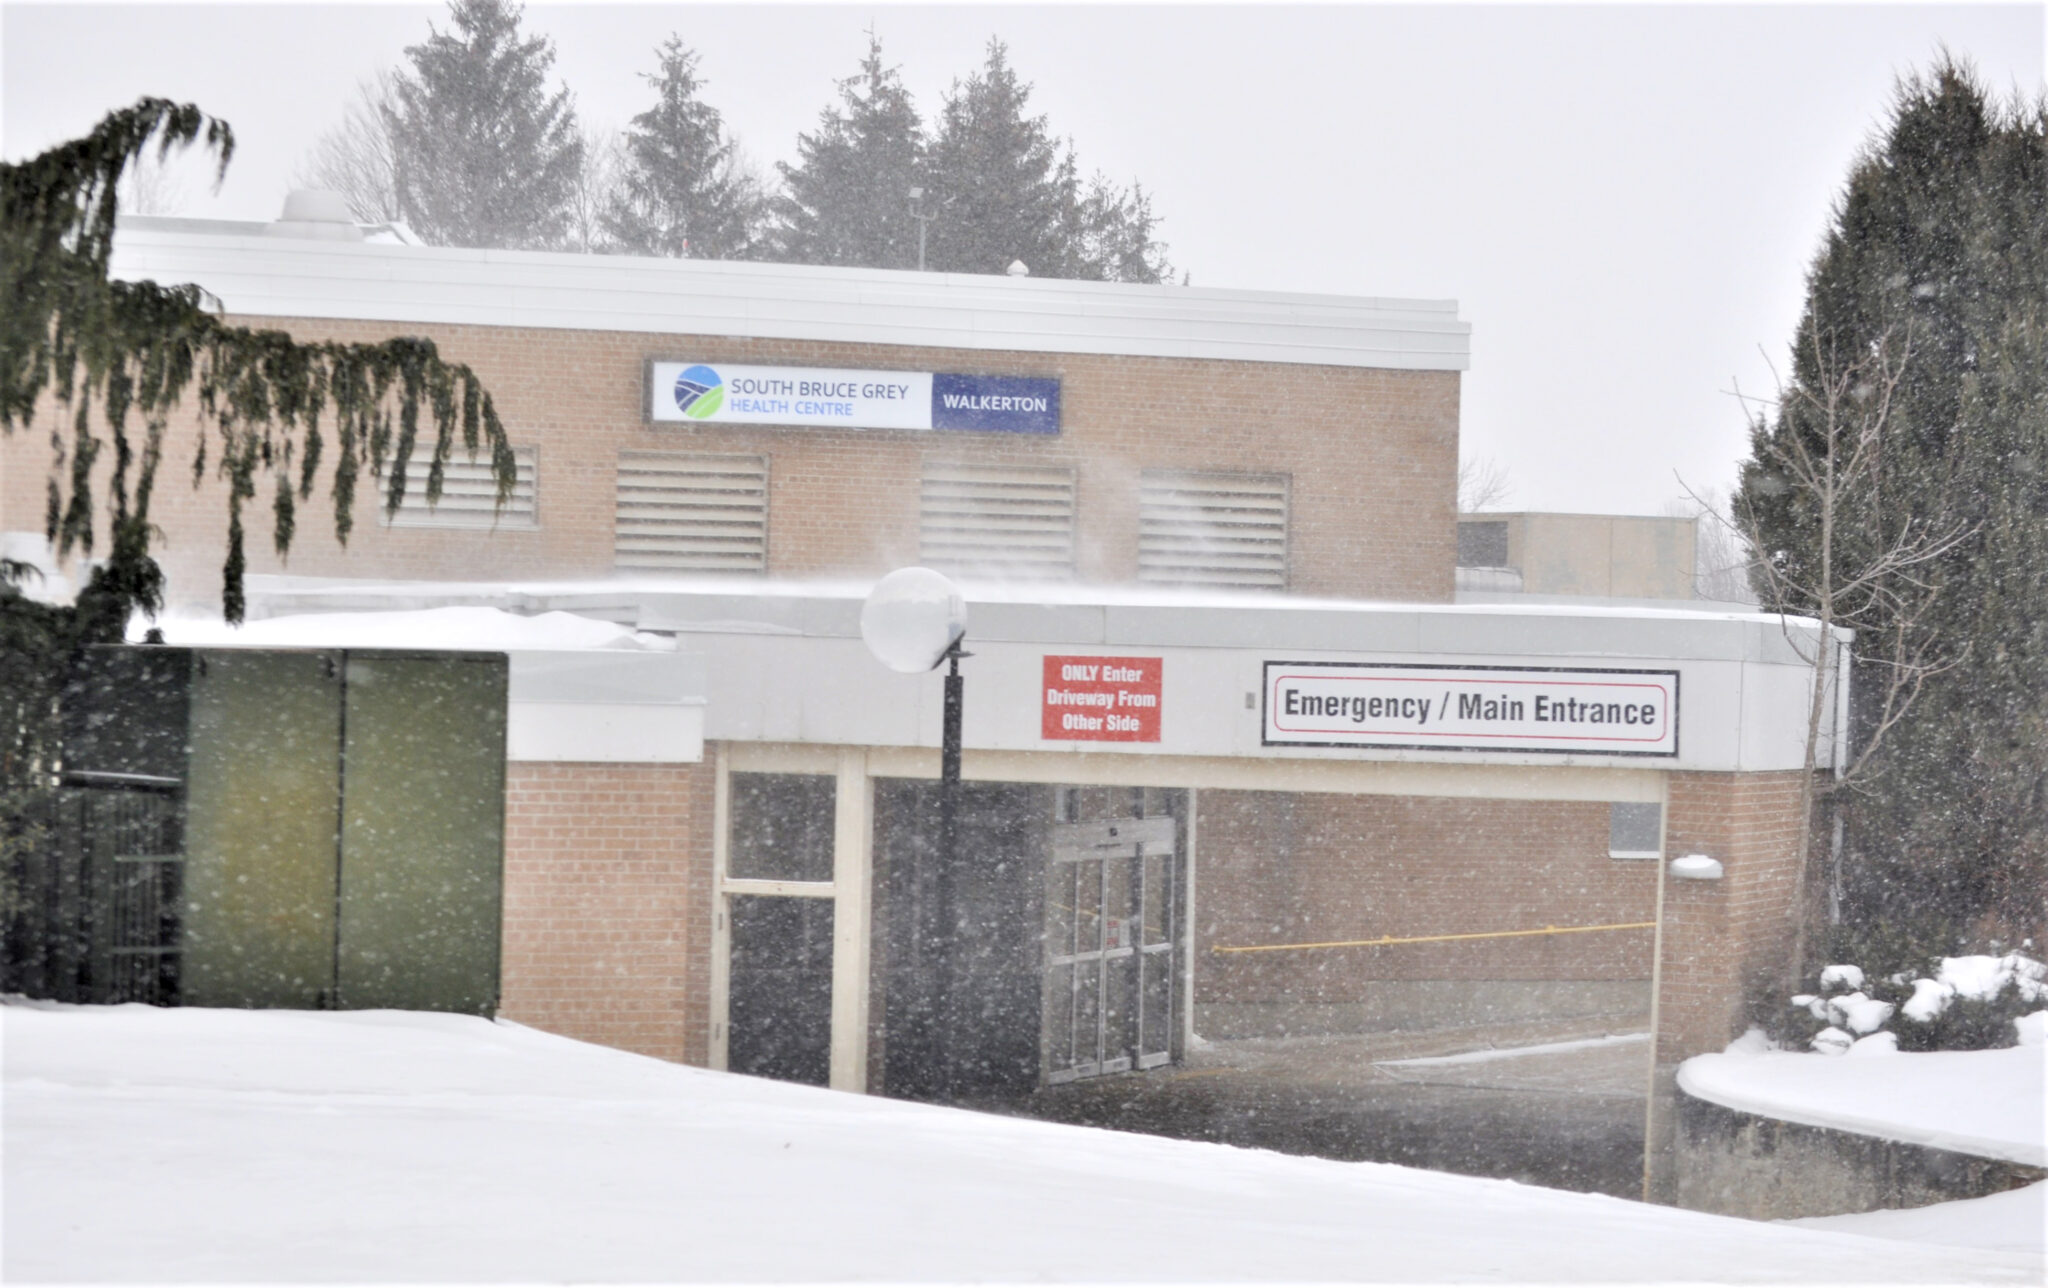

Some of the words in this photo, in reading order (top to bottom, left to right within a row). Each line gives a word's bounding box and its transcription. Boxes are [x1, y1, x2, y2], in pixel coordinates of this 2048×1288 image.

[730, 378, 793, 396] SOUTH
[800, 381, 857, 398] BRUCE
[862, 384, 908, 400] GREY
[730, 398, 789, 415] HEALTH
[794, 401, 853, 416] CENTRE
[943, 393, 1047, 412] WALKERTON
[1061, 664, 1099, 681] ONLY
[1102, 665, 1143, 682] Enter
[1047, 689, 1115, 709] Driveway
[1118, 690, 1156, 707] From
[1285, 689, 1431, 724] Emergency
[1439, 691, 1450, 721] /
[1458, 693, 1524, 721] Main
[1534, 695, 1656, 725] Entrance
[1062, 713, 1103, 730] Other
[1106, 714, 1140, 731] Side
